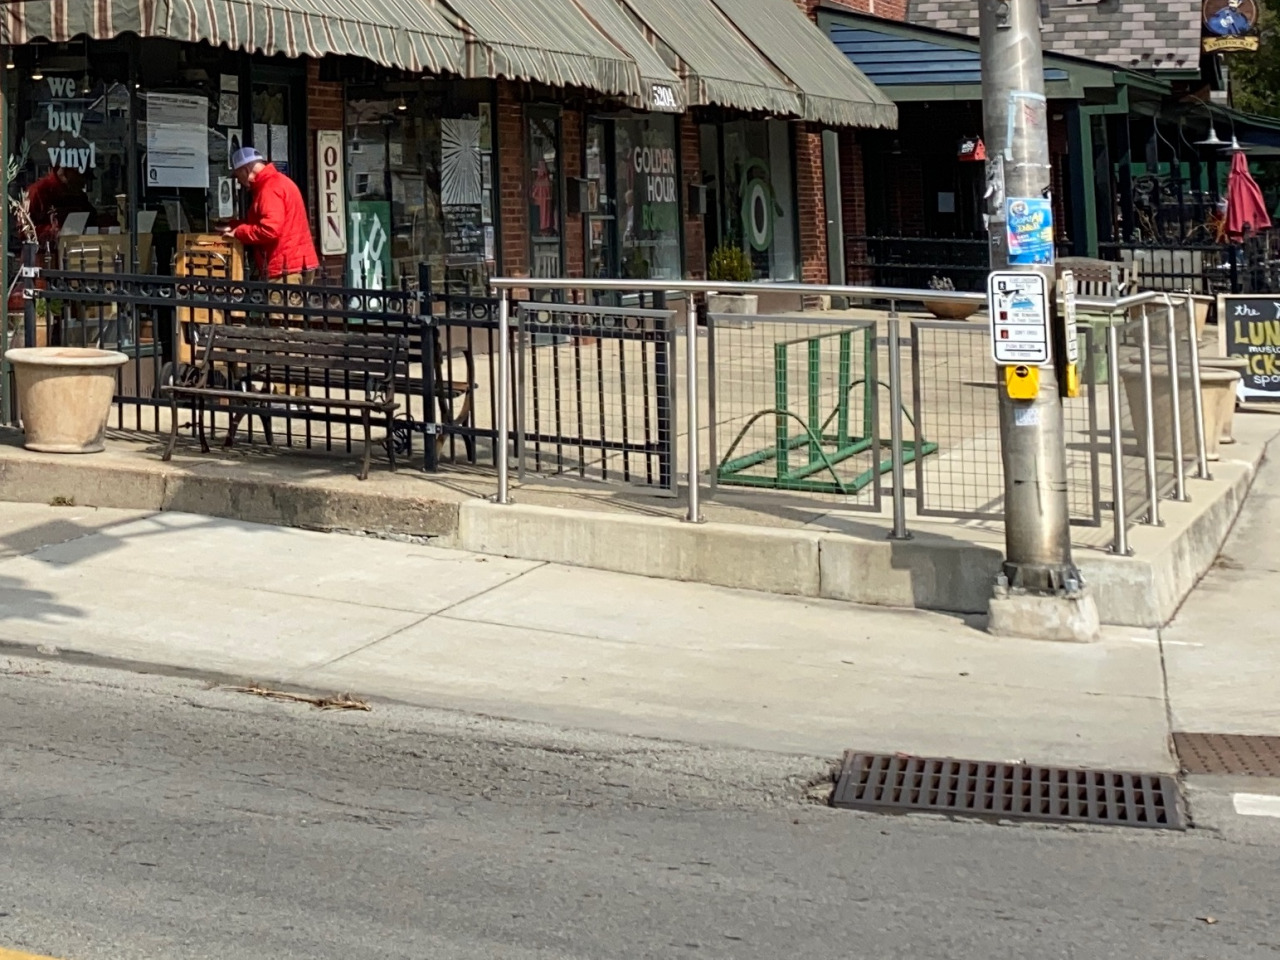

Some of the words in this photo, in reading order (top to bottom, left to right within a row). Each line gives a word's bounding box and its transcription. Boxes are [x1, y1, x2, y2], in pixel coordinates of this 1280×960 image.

[47, 76, 76, 98] we
[47, 103, 84, 138] buy
[47, 140, 96, 174] vinyl
[634, 146, 676, 174] GOLDEN
[323, 146, 341, 238] OPEN
[647, 175, 677, 202] HOUR
[1234, 304, 1261, 316] the
